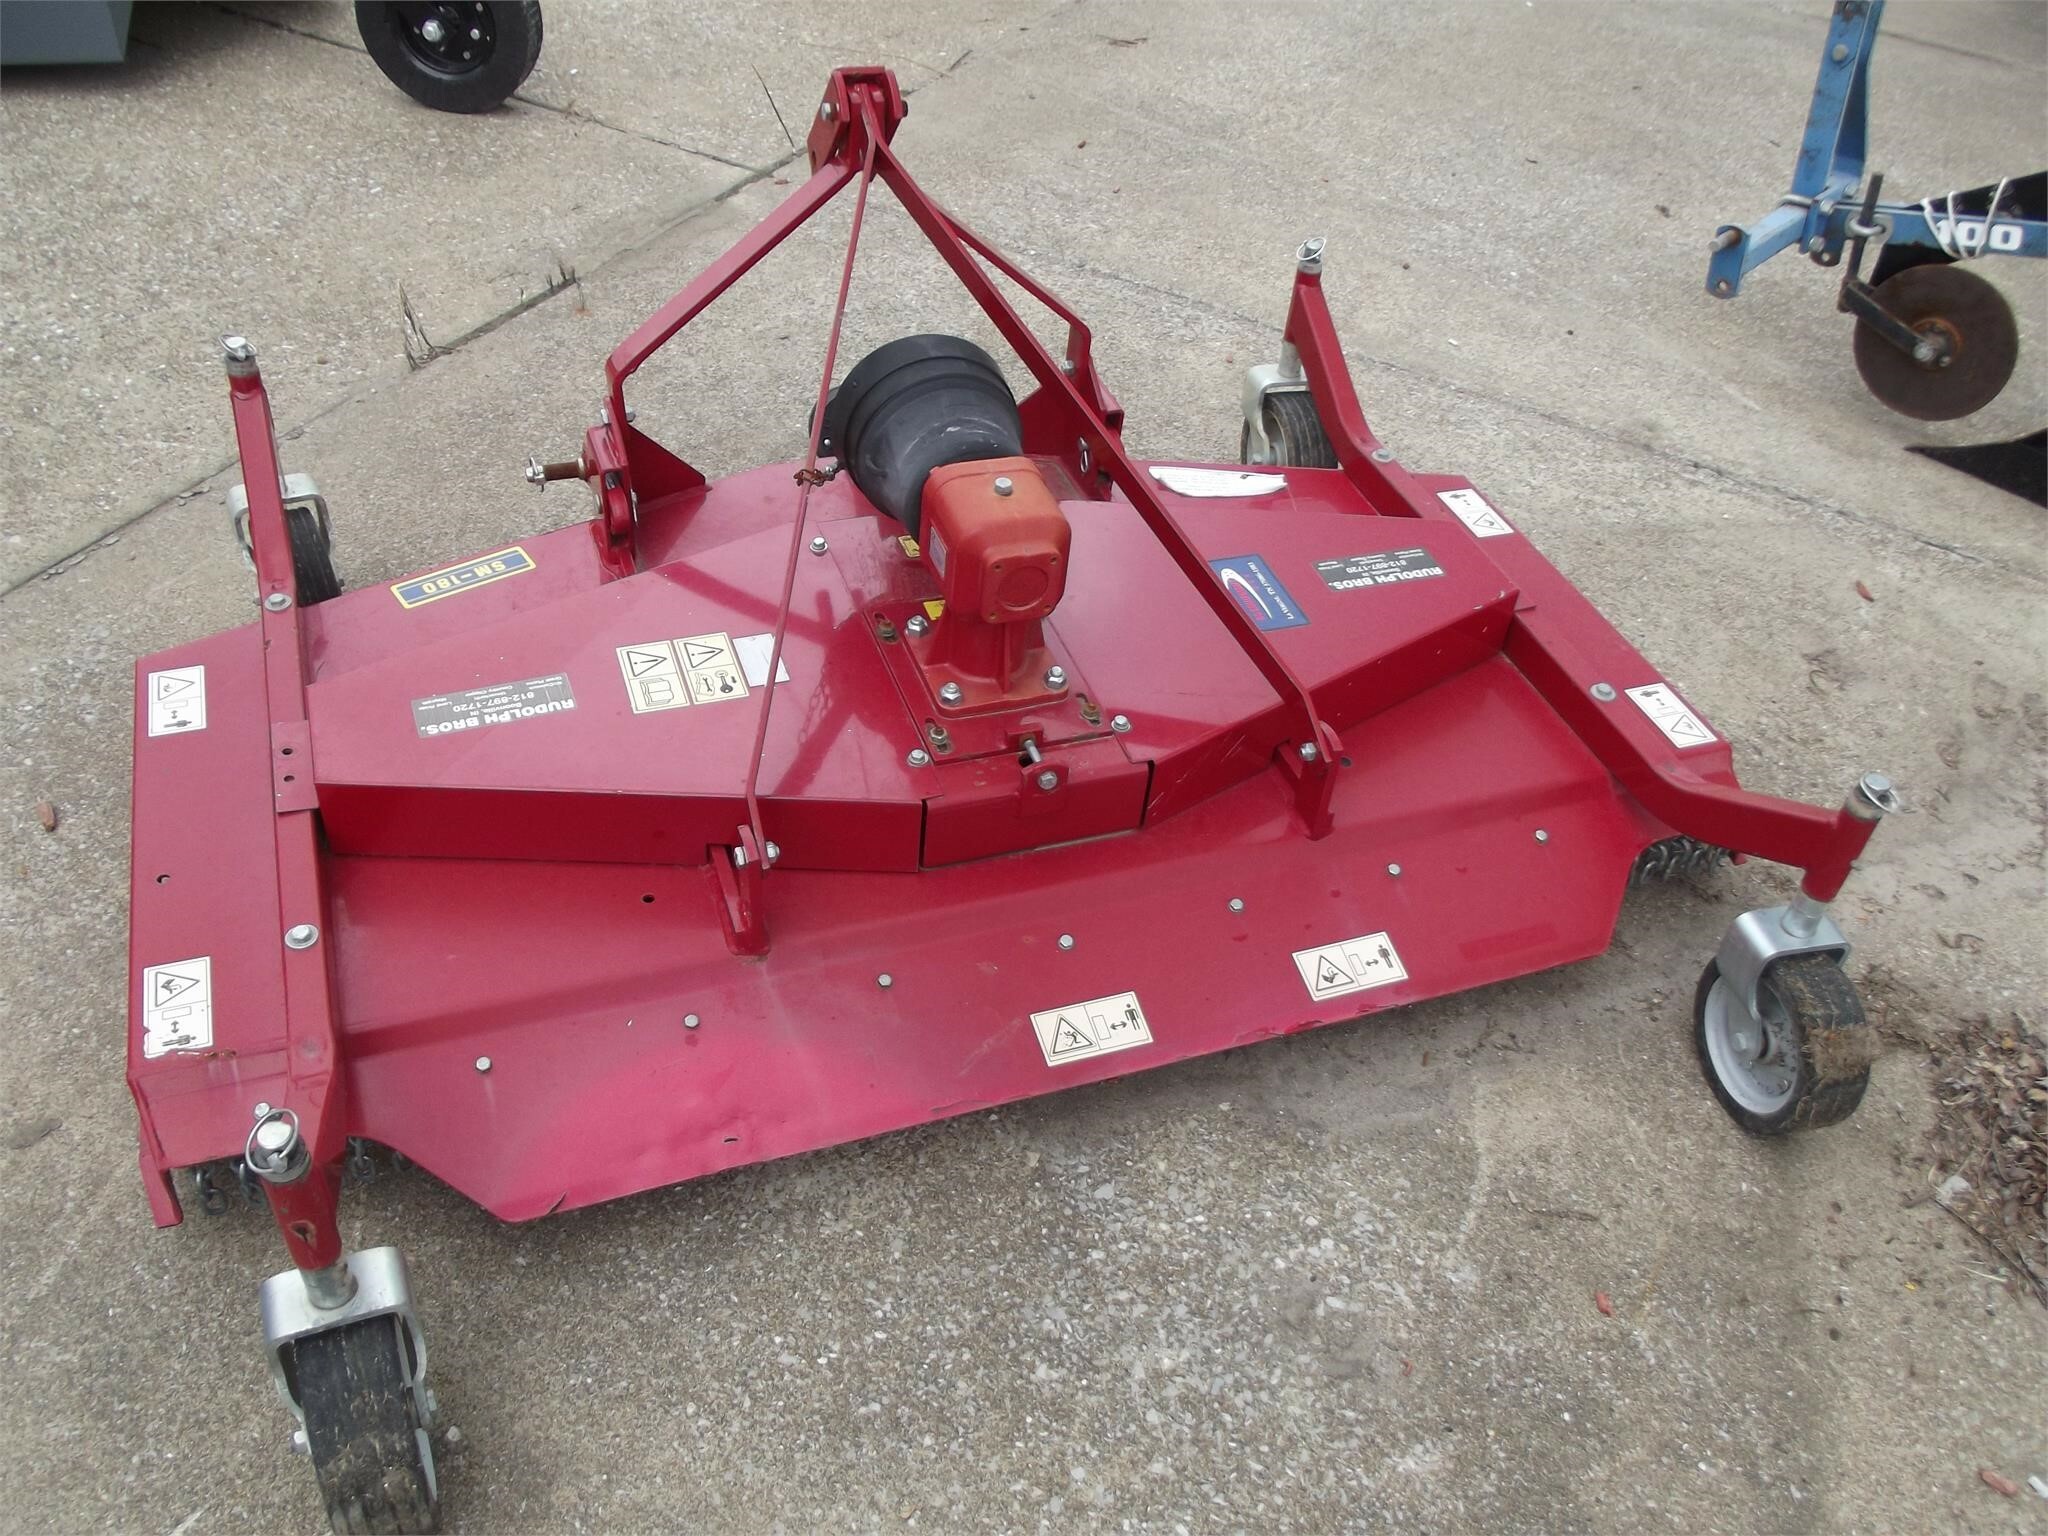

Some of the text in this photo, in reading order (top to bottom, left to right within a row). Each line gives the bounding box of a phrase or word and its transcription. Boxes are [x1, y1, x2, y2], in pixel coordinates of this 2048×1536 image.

[1936, 219, 2023, 251] 100
[421, 560, 506, 593] SM-180
[1328, 566, 1443, 590] RUDOLPH BROS.
[420, 699, 575, 735] RUDOLPH BROS.
[453, 691, 535, 713] 812-897-1720
